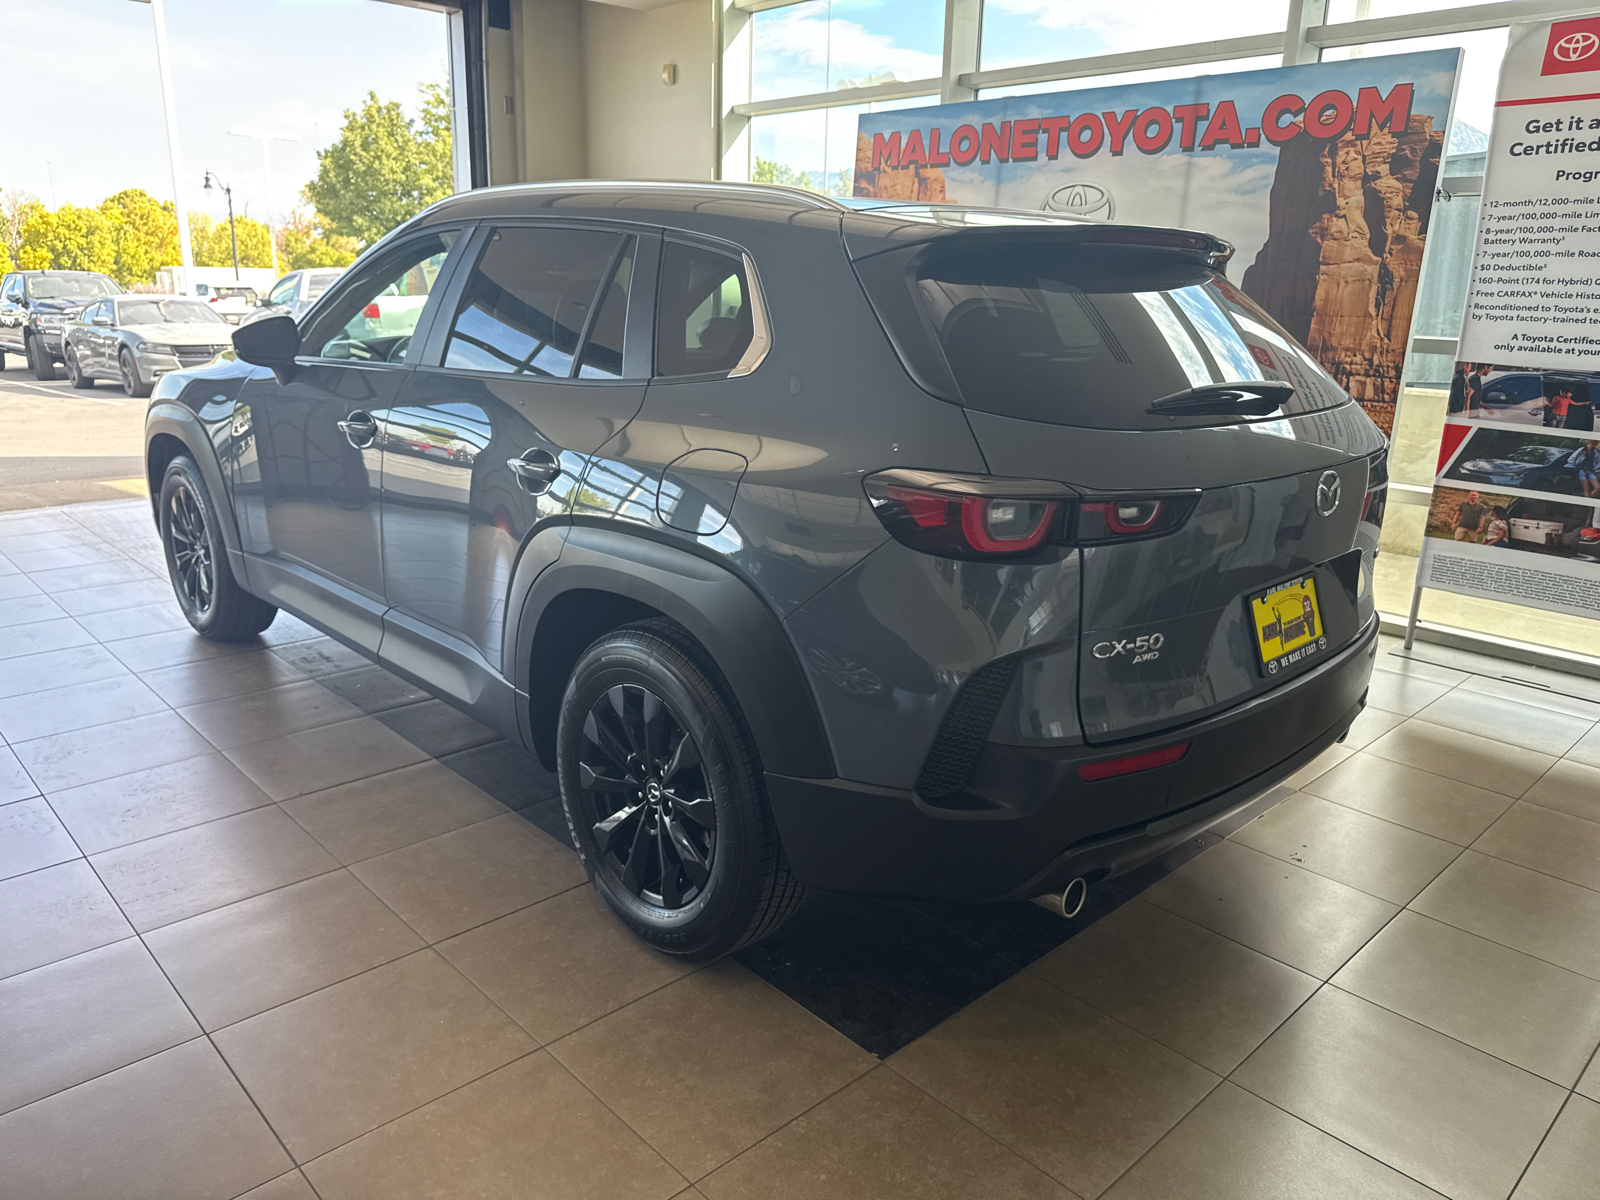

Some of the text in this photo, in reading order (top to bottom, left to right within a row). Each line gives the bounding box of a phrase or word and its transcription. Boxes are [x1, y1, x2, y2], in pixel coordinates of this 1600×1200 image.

[871, 82, 1414, 170] MALONETOYOTA.COM
[1525, 118, 1563, 134] Get
[1568, 115, 1583, 131] it
[1509, 136, 1600, 157] Certified
[1489, 197, 1595, 209] 12-month/12,000-mile
[1487, 212, 1583, 222] 7-year/100,000-mile
[1485, 226, 1579, 236] 8-year/100,000-mile
[1484, 237, 1517, 246] Battery
[1482, 250, 1576, 260] 7-year/100,000-mile
[1480, 263, 1491, 271] $0
[1478, 277, 1520, 285] 160-Point
[1521, 277, 1540, 286] (174
[1542, 277, 1556, 285] for
[1557, 278, 1593, 287] Hybrid)
[1476, 290, 1495, 298] Free
[1540, 291, 1573, 300] Vehicle
[1473, 303, 1539, 312] Reconditioned
[1541, 304, 1551, 312] to
[1472, 313, 1483, 321] by
[1484, 313, 1514, 322] Toyota
[1516, 314, 1587, 324] factory-trained
[1511, 333, 1518, 341] A
[1521, 333, 1554, 343] Toyota
[1494, 343, 1516, 352] only
[1517, 344, 1563, 354] available
[1565, 347, 1575, 355] at
[1304, 600, 1311, 612] 32
[1092, 633, 1164, 659] CX-50
[1132, 651, 1159, 665] AWD
[1280, 643, 1317, 668] WE MAKE IT EASY
